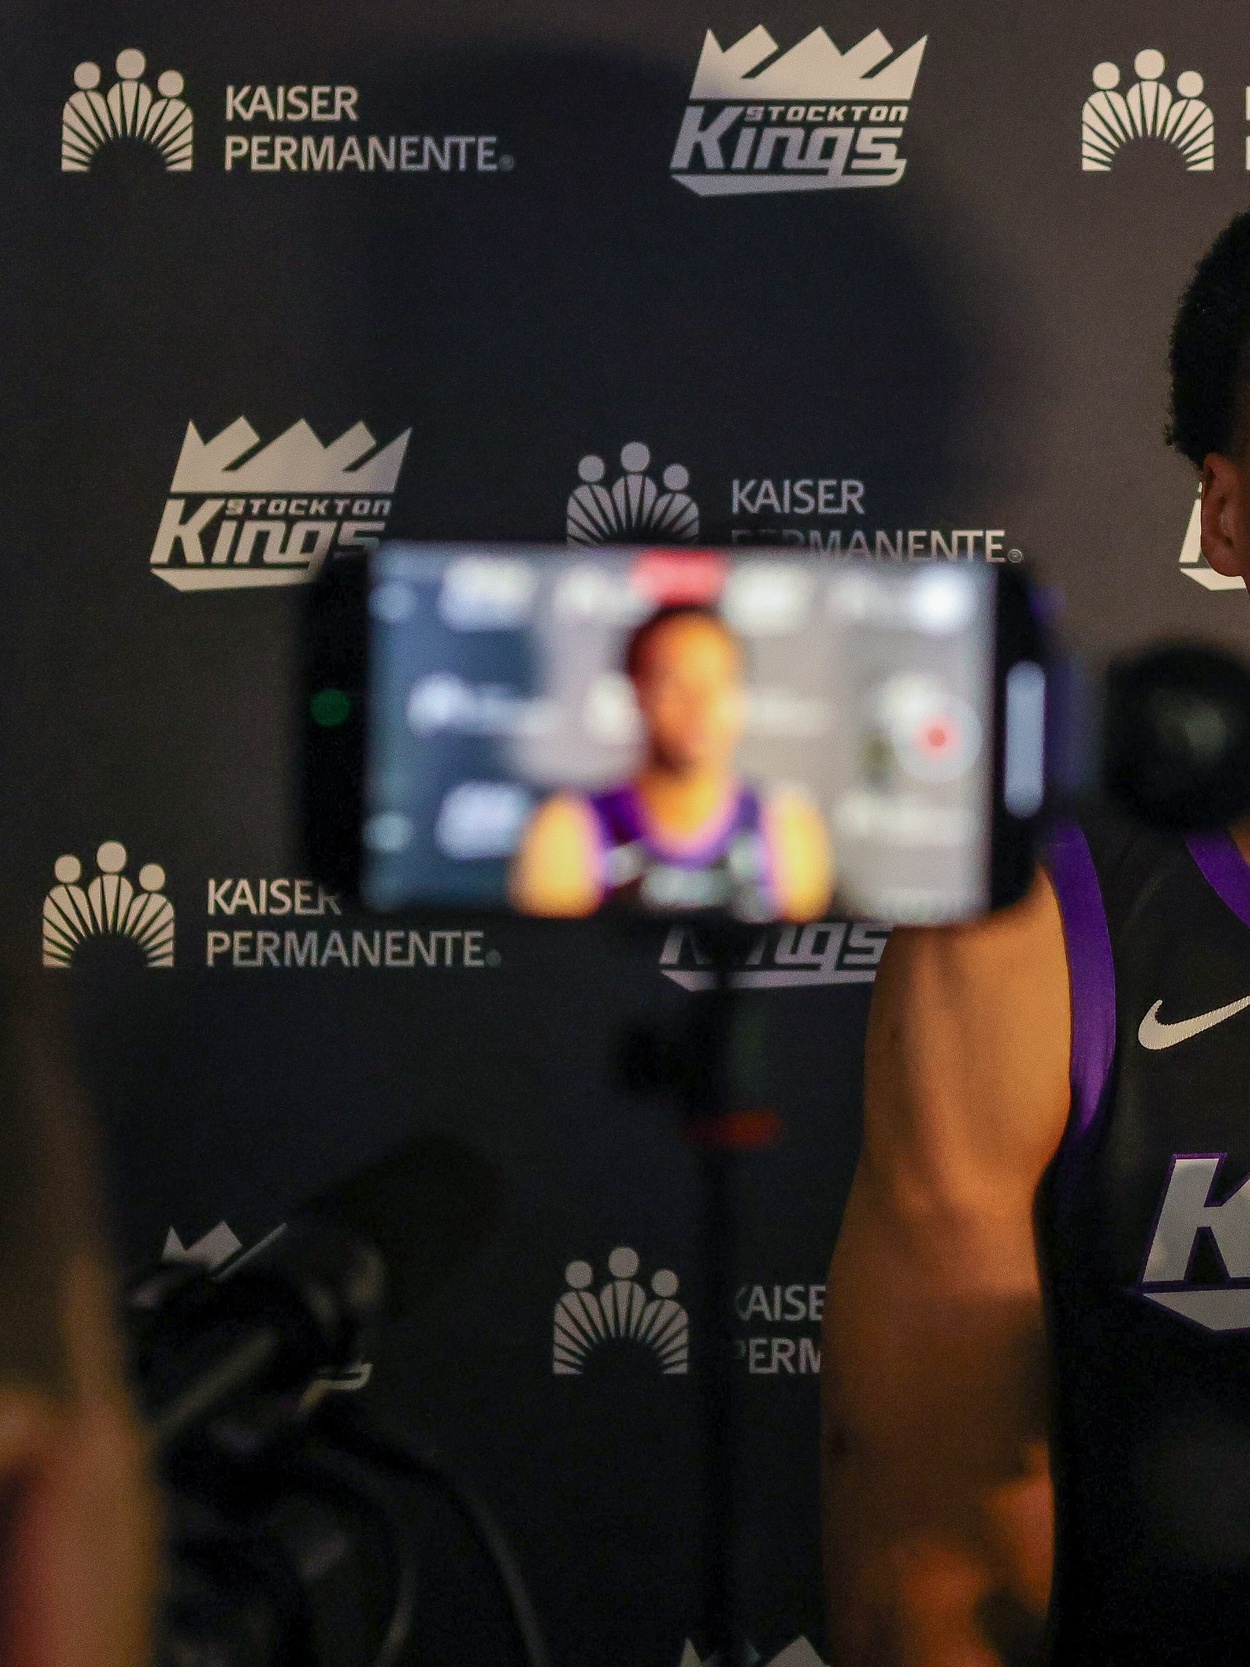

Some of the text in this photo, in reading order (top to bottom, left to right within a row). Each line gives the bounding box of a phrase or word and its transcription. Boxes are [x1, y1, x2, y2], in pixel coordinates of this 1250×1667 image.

[225, 85, 360, 121] KAISER
[743, 105, 909, 122] STOCKTON
[669, 105, 908, 180] Kings
[224, 498, 392, 516] STOCKTON
[731, 478, 866, 515] KAISER
